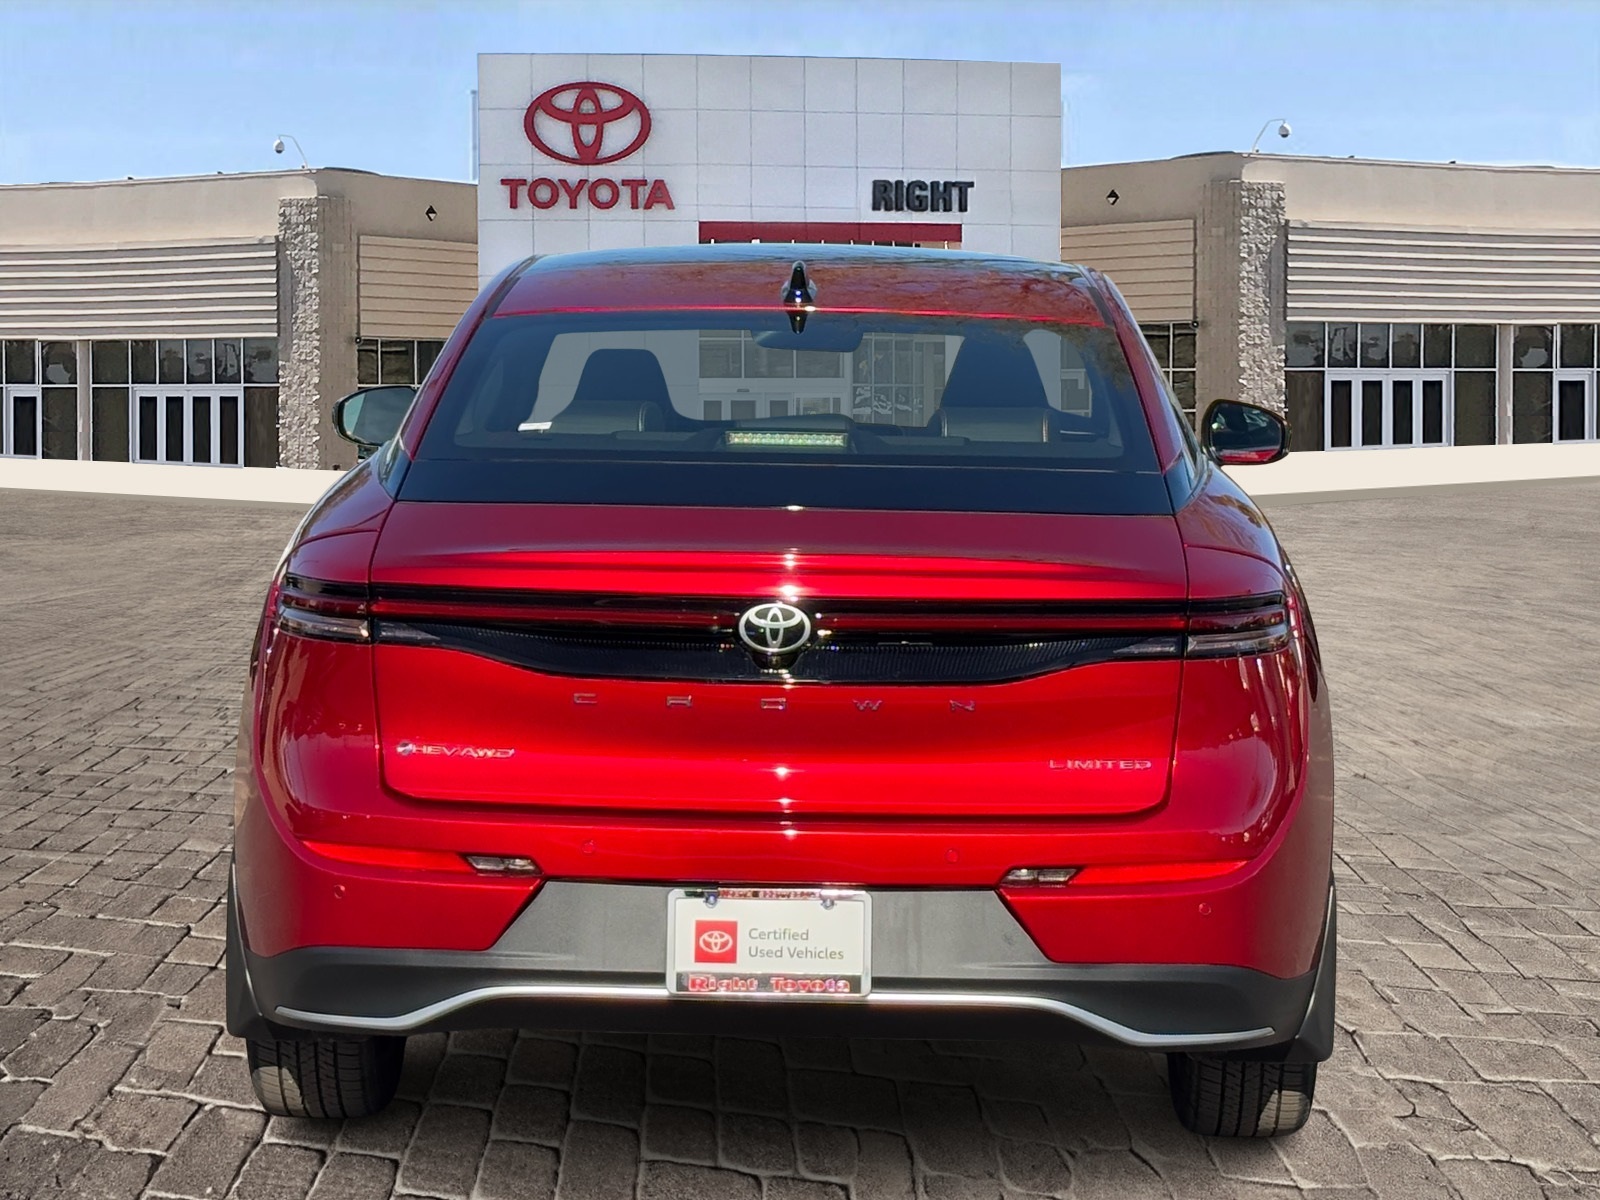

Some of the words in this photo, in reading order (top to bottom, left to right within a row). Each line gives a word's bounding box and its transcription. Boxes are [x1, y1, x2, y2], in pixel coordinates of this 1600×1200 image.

[501, 178, 675, 210] TOYOTA
[871, 179, 975, 213] RIGHT
[574, 693, 976, 711] CROWN
[1049, 759, 1152, 770] LIMITED
[748, 927, 809, 941] Certified
[748, 946, 783, 958] Used
[787, 947, 844, 960] Vehicles
[688, 974, 759, 993] Right
[770, 976, 851, 993] Toyota
